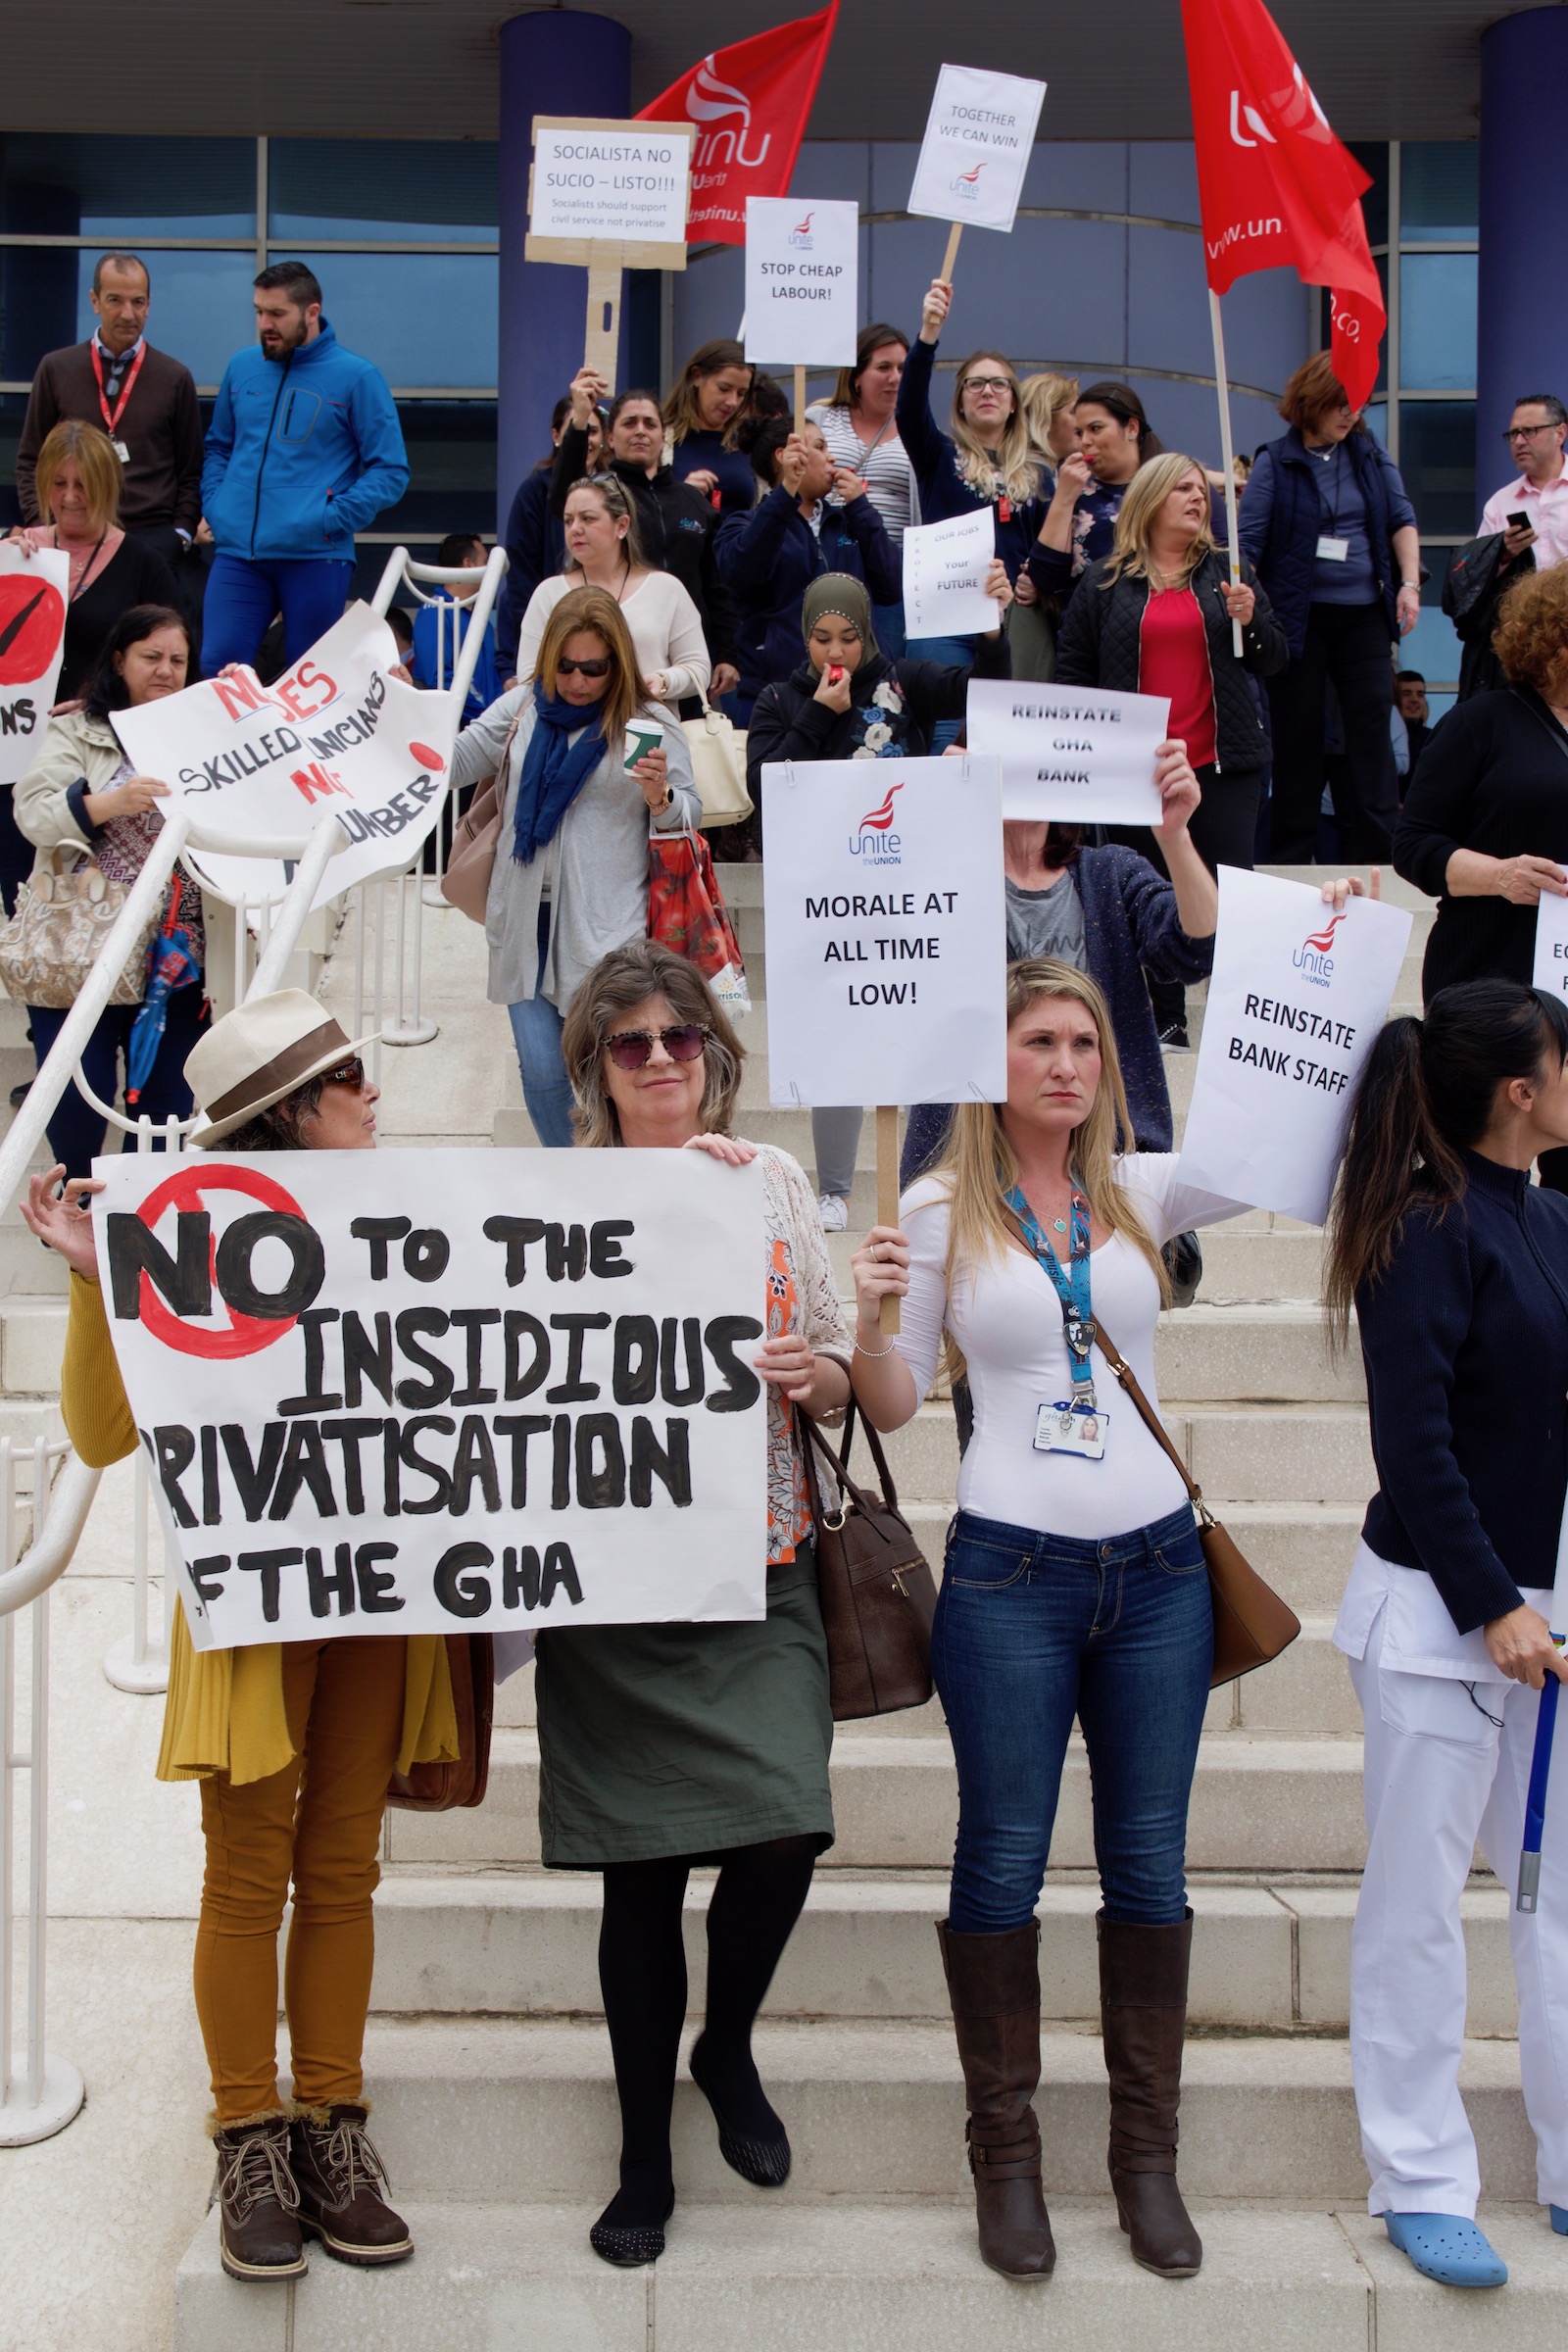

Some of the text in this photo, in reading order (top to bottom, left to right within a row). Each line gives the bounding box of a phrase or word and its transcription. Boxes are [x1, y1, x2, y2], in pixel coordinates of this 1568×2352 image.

[951, 105, 1016, 127] TOGETHER
[940, 124, 1018, 148] WE CAN WIN
[553, 144, 671, 164] SOCIALISTA NO
[546, 172, 595, 188] SUCIO
[613, 175, 675, 192] LISTO!!!
[949, 180, 979, 196] unite
[552, 198, 667, 213] Socialists should support
[551, 215, 666, 228] civil service not privatise
[788, 234, 813, 246] unite
[760, 262, 843, 277] STOP CHEAP
[771, 286, 831, 300] LABOUR!
[934, 525, 980, 543] OUR JOBS
[945, 560, 969, 569] Your
[937, 578, 979, 590] FUTURE
[1012, 704, 1122, 723] REINSTATE
[1053, 737, 1094, 753] GHA
[178, 726, 302, 797] SKILLED
[1037, 768, 1092, 785] BANK
[335, 774, 441, 844] UMBER
[849, 831, 902, 856] unite
[806, 892, 958, 919] MORALE AT
[823, 937, 941, 963] ALL TIME
[1292, 949, 1334, 978] unite
[848, 981, 917, 1006] LOW!
[1244, 993, 1356, 1051] REINSTATE
[1228, 1037, 1348, 1096] BANK STAFF
[105, 1210, 637, 1320] NO TO THE
[276, 1306, 764, 1418] INSIDIOUS
[139, 1413, 693, 1529] RIVATISATION
[185, 1541, 586, 1623] F THE GHA
